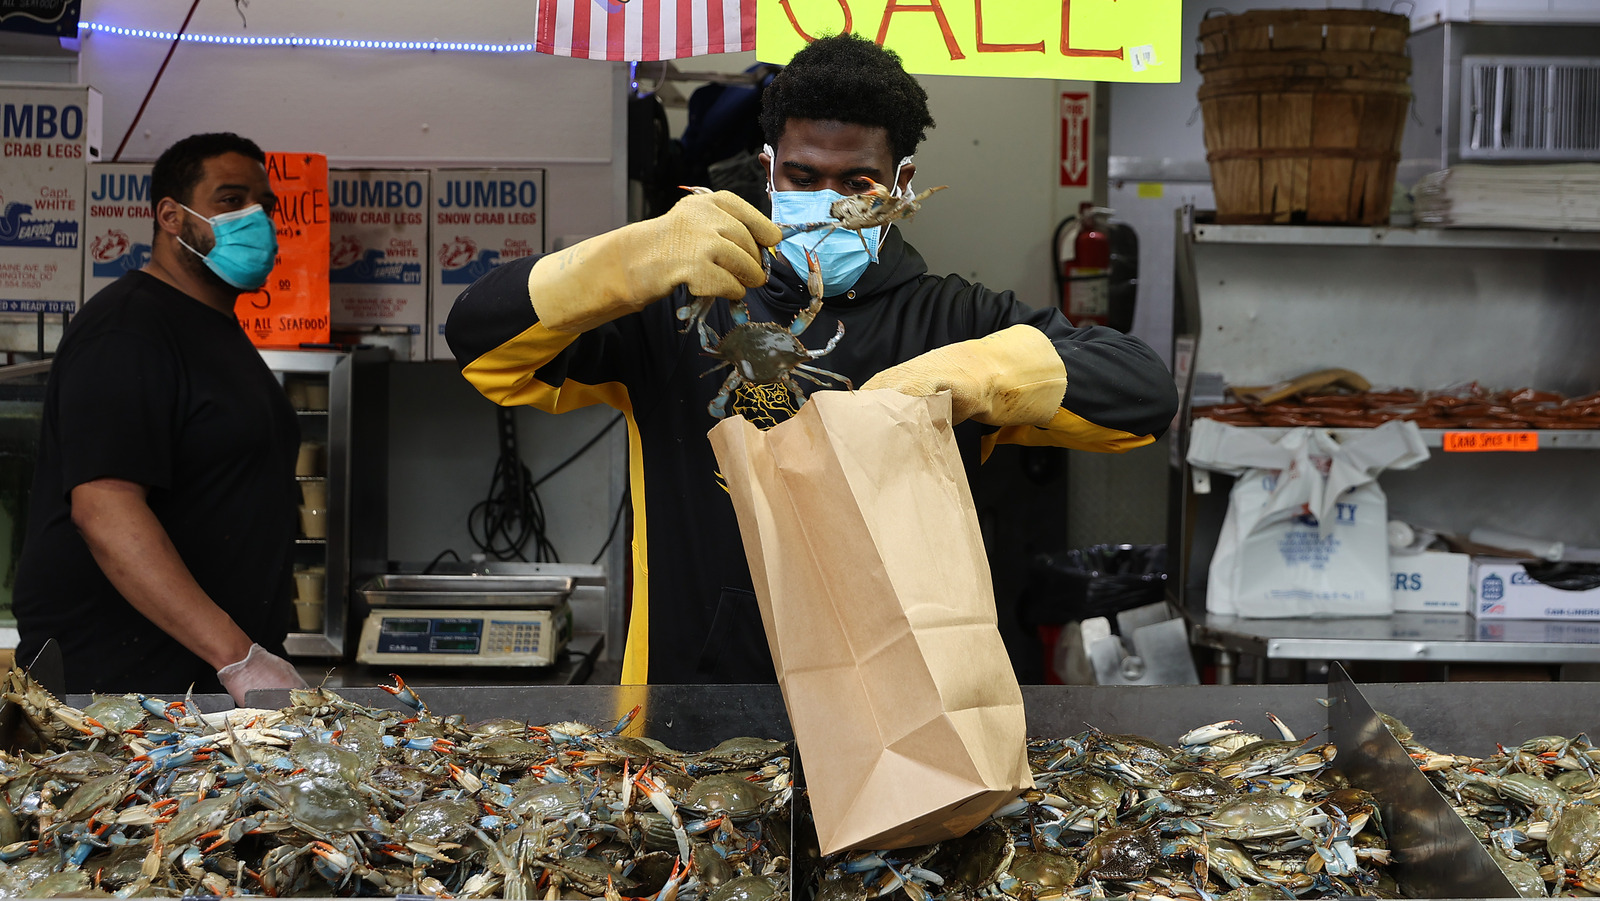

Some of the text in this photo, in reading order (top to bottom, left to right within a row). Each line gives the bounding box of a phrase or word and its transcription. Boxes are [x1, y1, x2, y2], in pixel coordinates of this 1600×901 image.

[0, 104, 83, 140] MBO
[4, 142, 83, 158] CRAB LEGS
[40, 186, 72, 199] Capt.
[329, 180, 423, 208] JUMBO
[438, 180, 537, 208] JUMBO
[34, 199, 77, 211] WHITE
[91, 205, 125, 218] SNOW
[330, 211, 423, 225] NOW CRAB LEGS
[438, 212, 537, 225] SNOW CRAB LEGS
[55, 232, 77, 247] CITY
[386, 248, 419, 257] WHITE
[501, 248, 534, 257] WHITE
[21, 301, 46, 312] READY
[49, 302, 59, 312] TO
[61, 302, 76, 312] EAT
[254, 318, 272, 330] ALL
[279, 315, 328, 332] SEAFOOD!
[1391, 572, 1422, 591] RS
